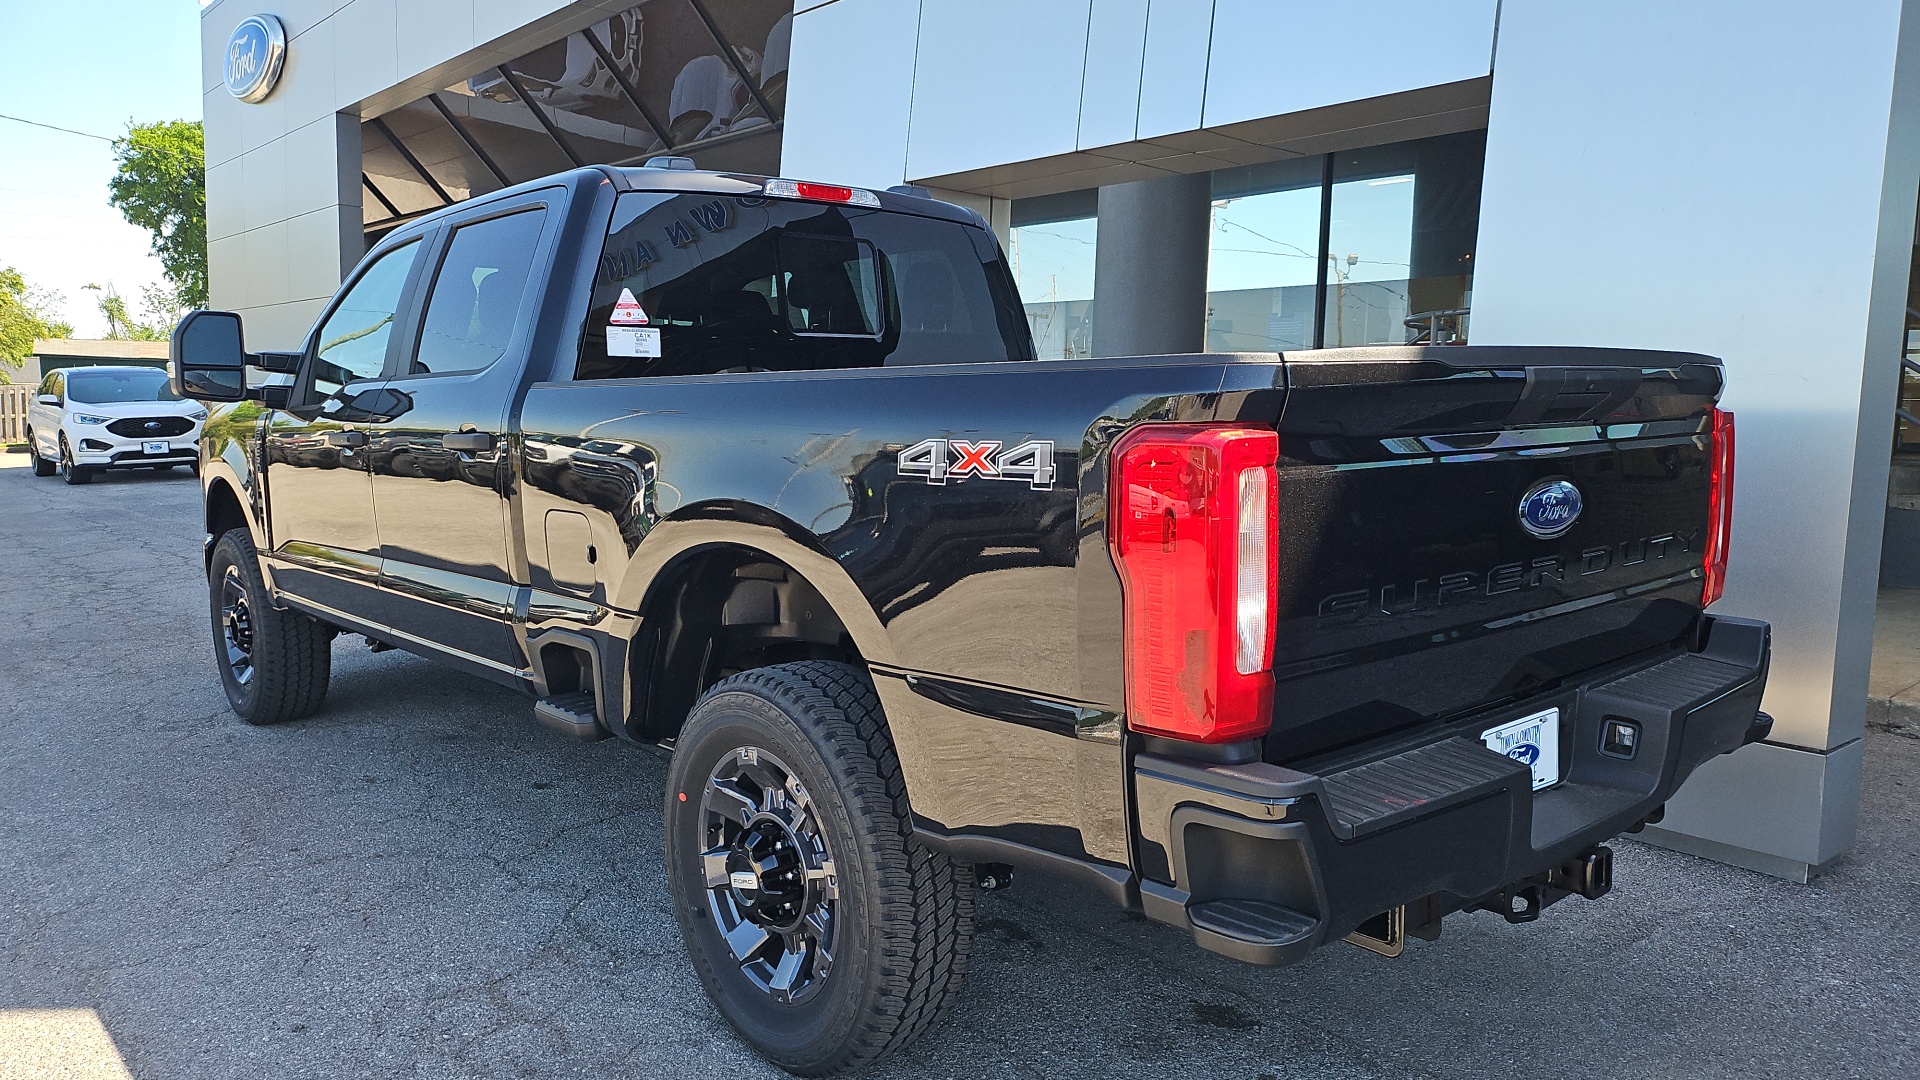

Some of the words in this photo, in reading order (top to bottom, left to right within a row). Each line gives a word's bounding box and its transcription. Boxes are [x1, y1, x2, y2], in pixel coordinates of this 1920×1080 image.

[228, 34, 256, 85] Ford
[1538, 493, 1572, 521] Ford
[1317, 555, 1567, 630] SUPER
[1581, 527, 1699, 576] DUTY
